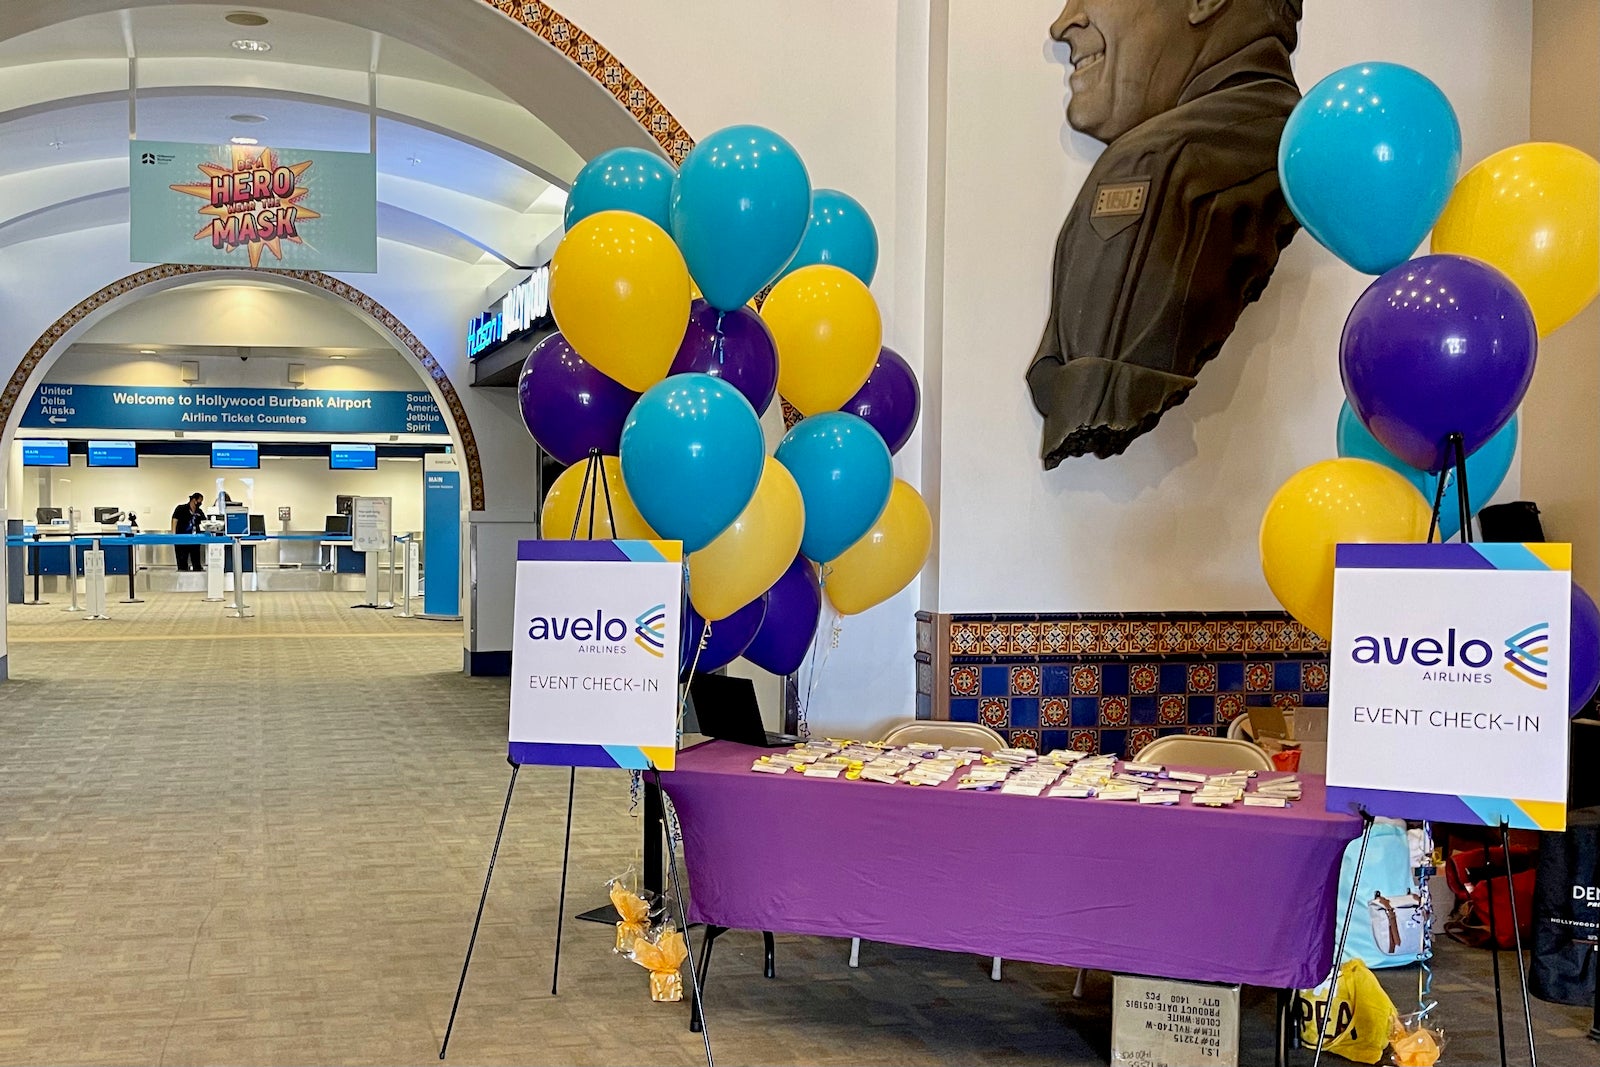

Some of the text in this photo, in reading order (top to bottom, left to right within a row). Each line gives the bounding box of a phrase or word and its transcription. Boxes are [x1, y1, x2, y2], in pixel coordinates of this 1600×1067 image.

[238, 156, 264, 171] BE A
[211, 167, 295, 207] HERO
[227, 198, 281, 213] WEAR THE
[212, 207, 298, 249] MASK
[40, 386, 73, 396] United
[40, 396, 66, 405] Delta
[113, 393, 372, 410] Welcome to Hollywood Burbank Airport
[41, 406, 76, 415] Alaska
[181, 413, 307, 424] Airline Ticket Counters
[406, 413, 440, 422] Jetblue
[406, 422, 431, 432] Spirit
[528, 609, 627, 641] avelo
[578, 645, 627, 654] AIRLINES
[1351, 628, 1493, 668] avelo
[529, 675, 658, 692] EVENT CHECK-IN
[1422, 672, 1493, 684] AIRLINES
[1354, 707, 1540, 732] EVENT CHECK-IN
[1550, 917, 1595, 928] HOLLYWOOD
[1145, 991, 1161, 1000] PCS
[1170, 995, 1189, 1004] 1400
[1181, 1005, 1220, 1017] PRODUCT
